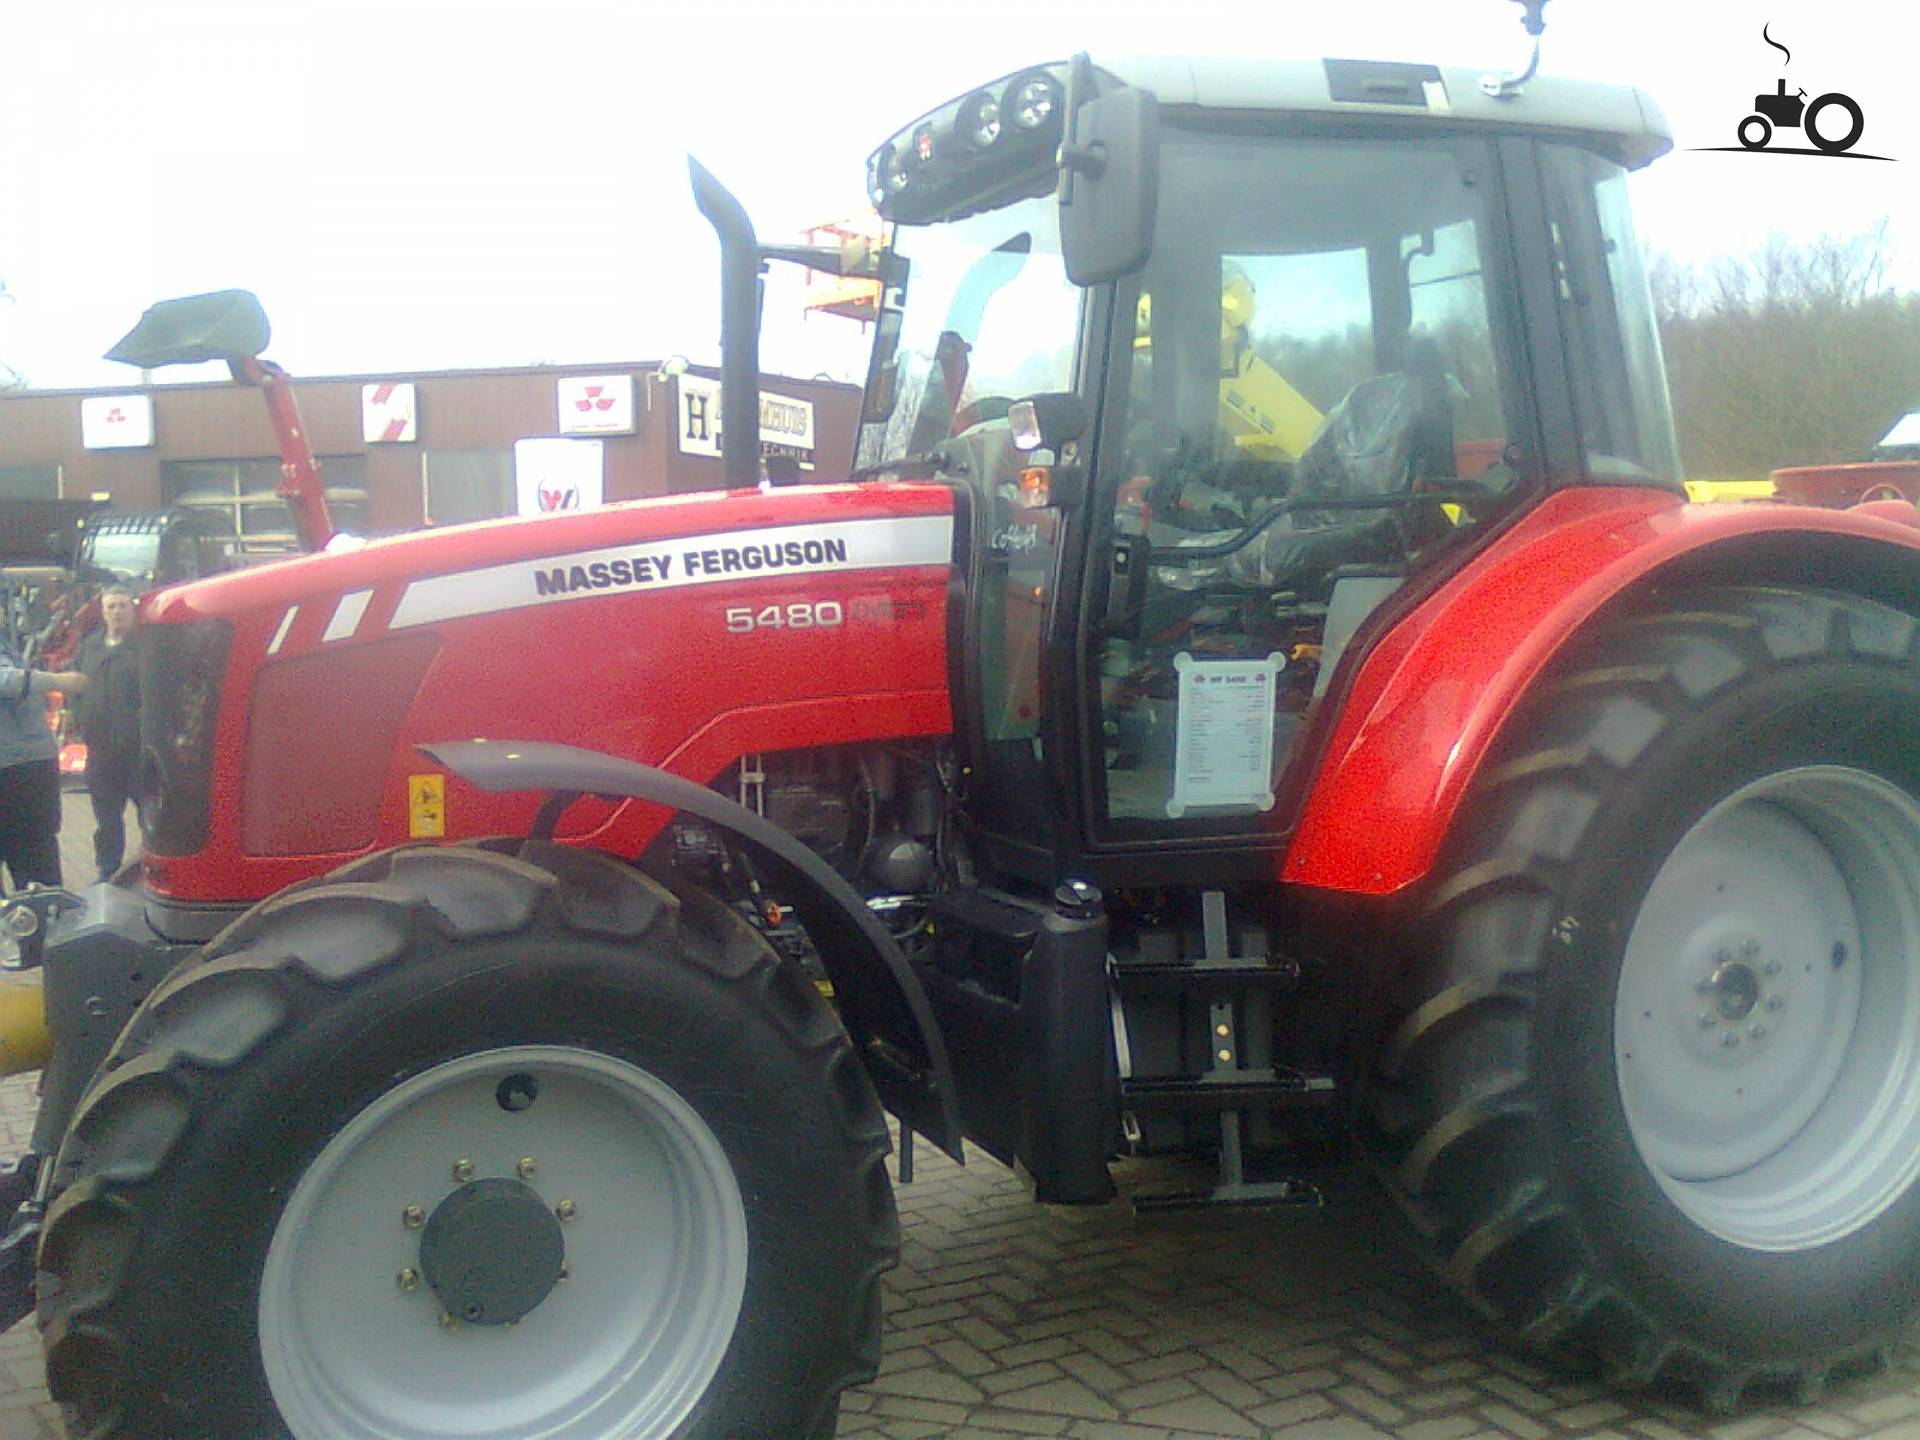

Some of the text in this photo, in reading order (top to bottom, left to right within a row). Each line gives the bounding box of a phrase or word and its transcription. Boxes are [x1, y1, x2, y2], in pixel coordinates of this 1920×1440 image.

[534, 538, 848, 597] MASSEY FERGUSON
[726, 601, 842, 633] 5480
